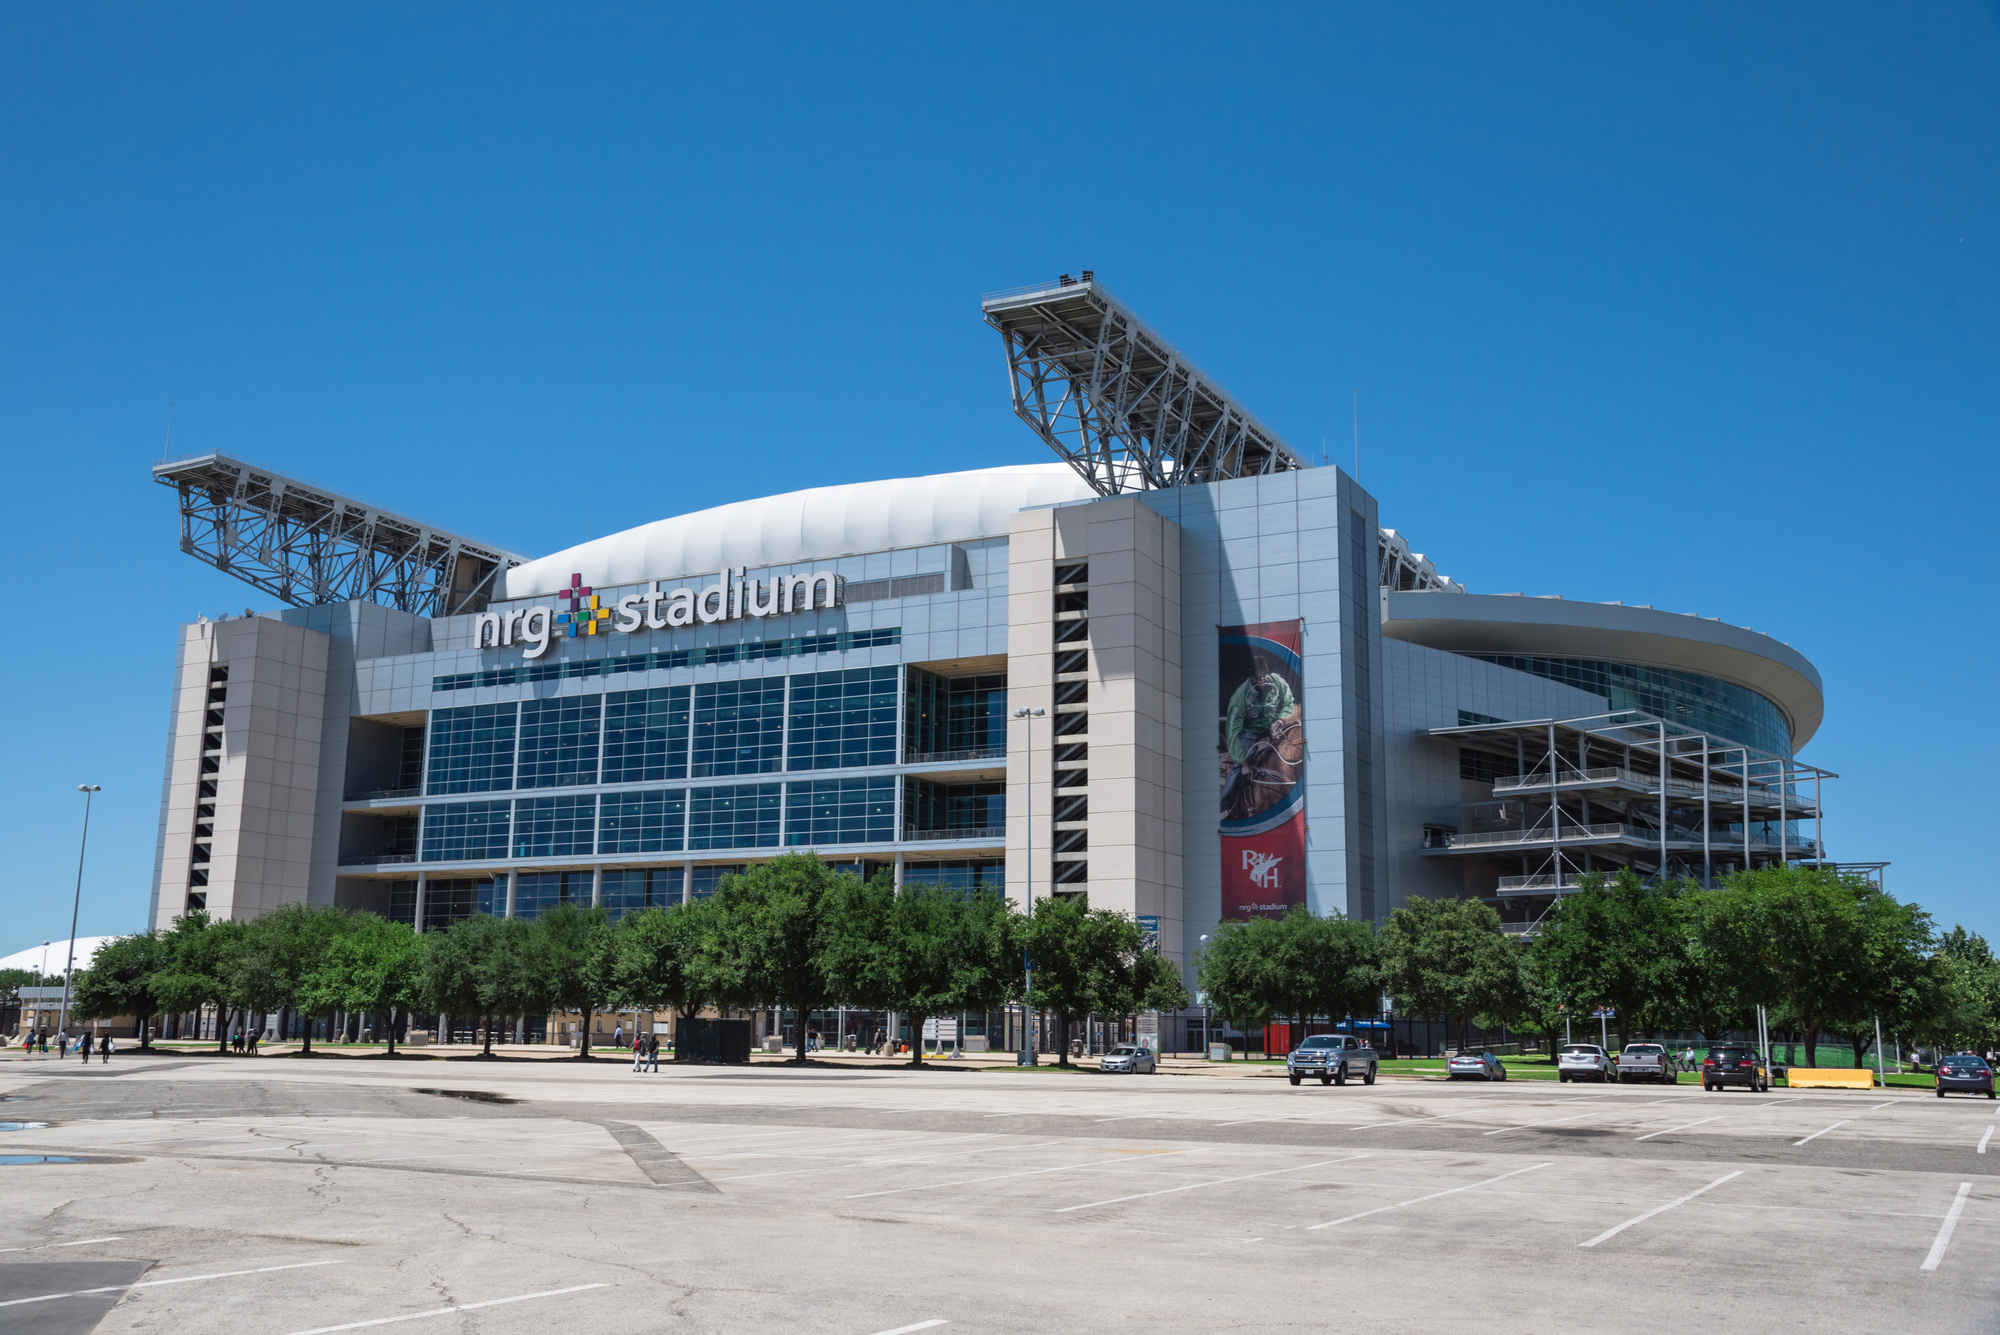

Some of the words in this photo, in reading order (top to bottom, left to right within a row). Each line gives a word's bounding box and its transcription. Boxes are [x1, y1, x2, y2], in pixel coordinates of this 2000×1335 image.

[474, 604, 553, 659] nrg
[615, 566, 837, 633] stadium
[1239, 904, 1252, 912] nrg
[1259, 902, 1288, 910] stadium
